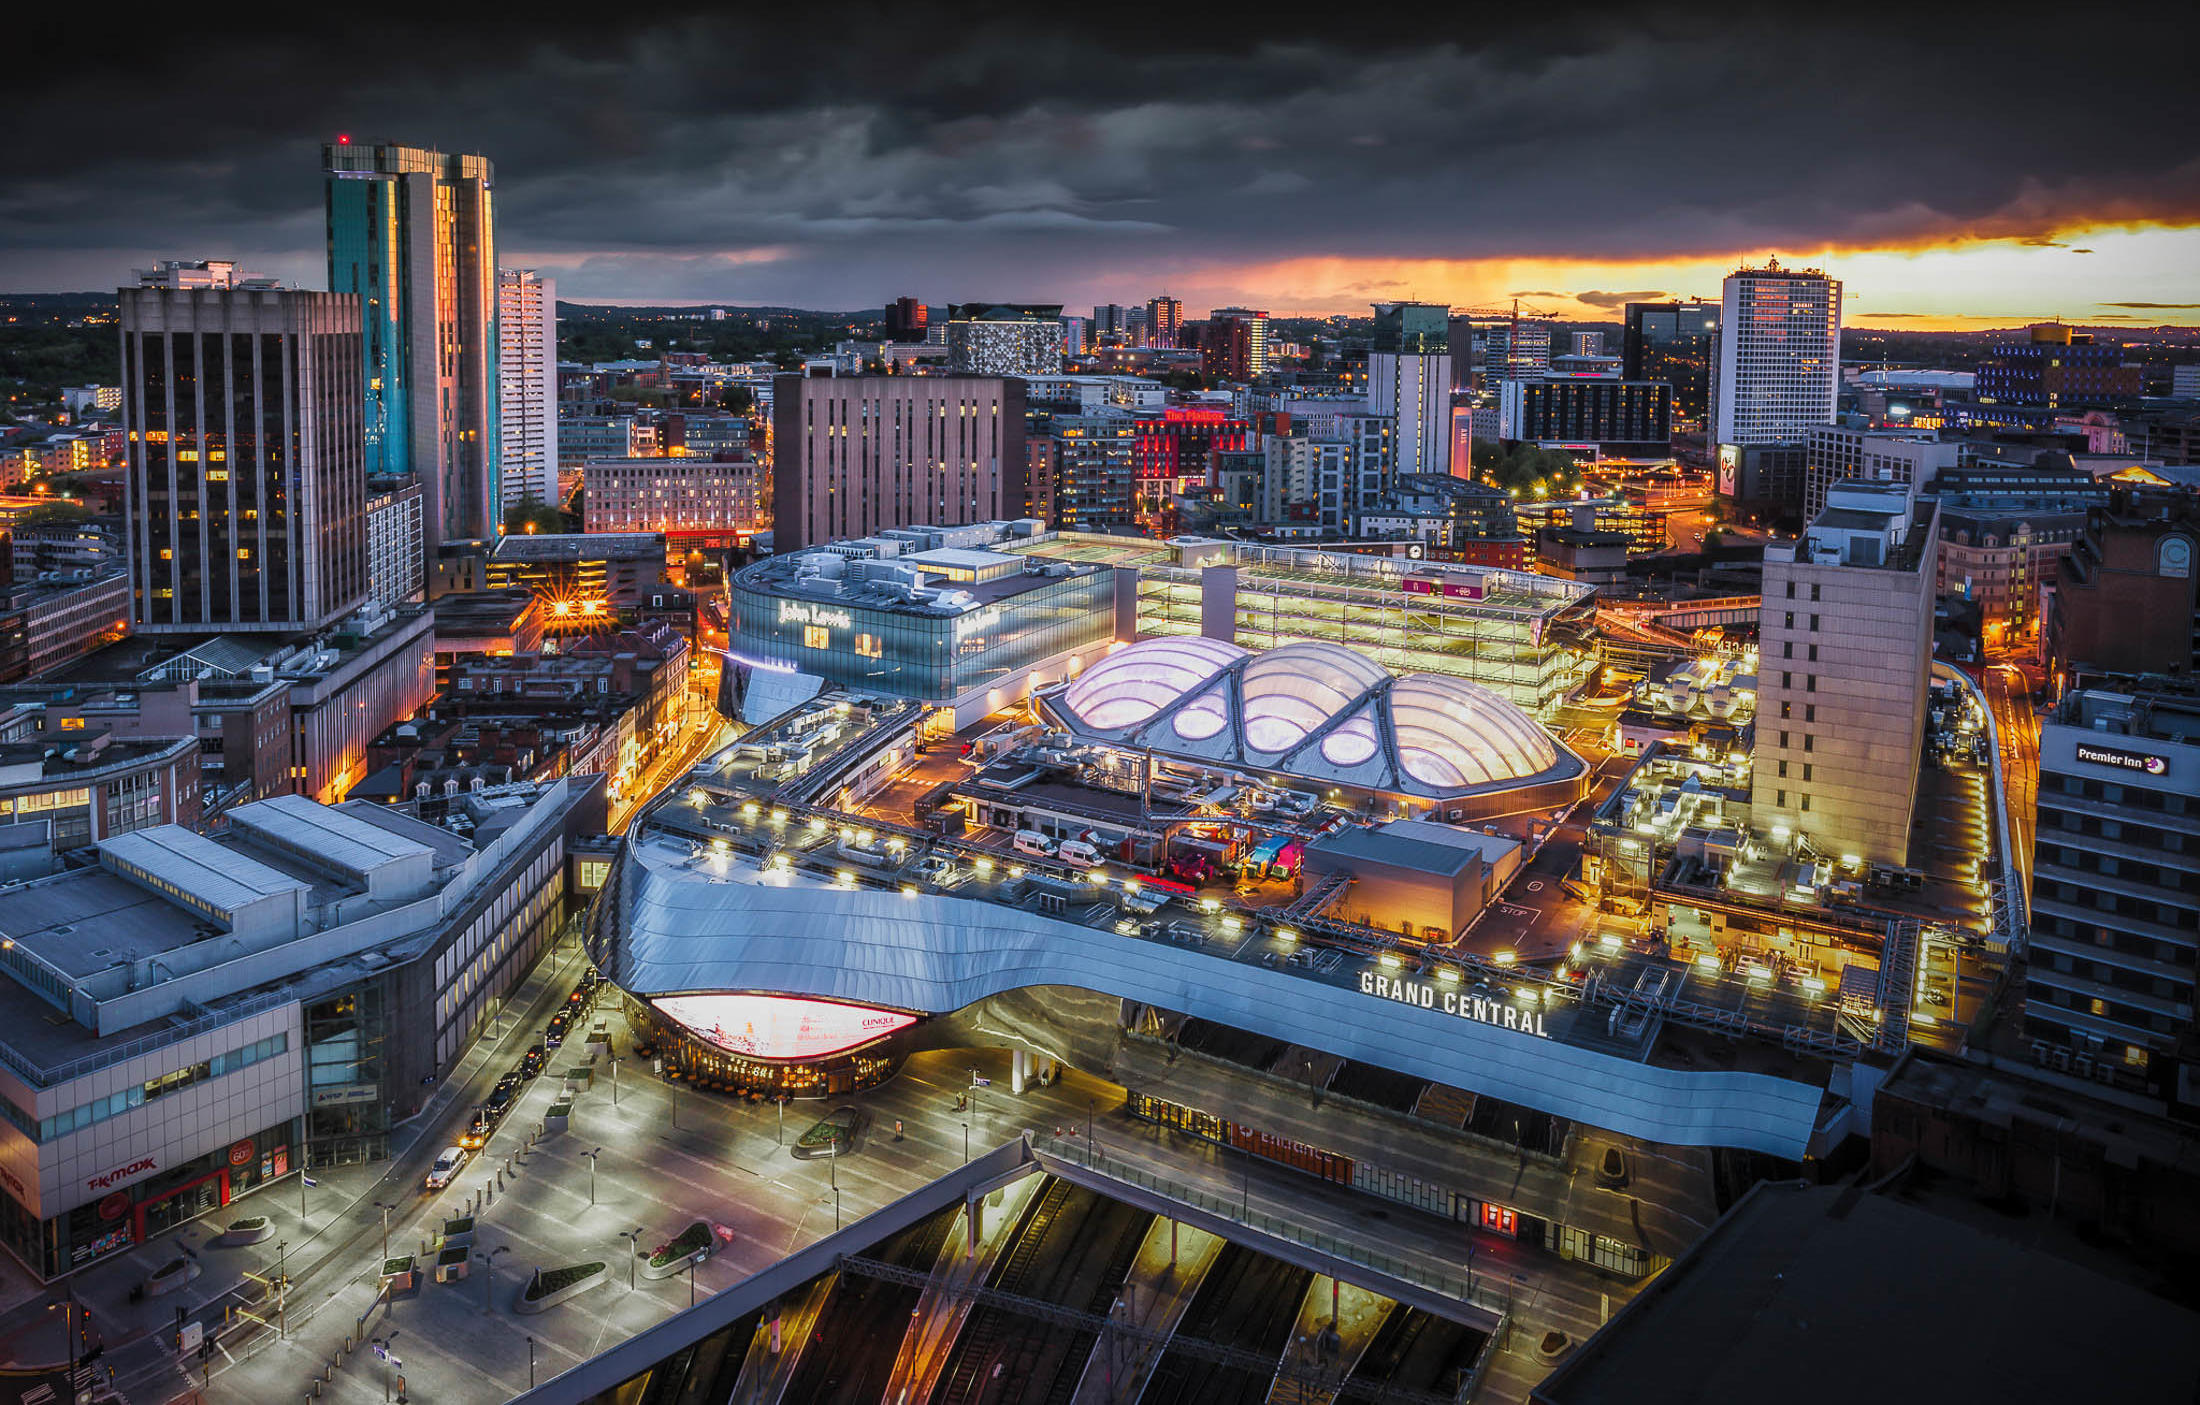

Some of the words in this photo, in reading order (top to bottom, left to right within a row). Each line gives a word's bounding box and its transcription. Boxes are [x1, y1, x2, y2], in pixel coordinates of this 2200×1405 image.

[779, 600, 809, 624] John
[811, 604, 850, 629] Lewis
[2079, 748, 2123, 764] Premier
[2124, 756, 2142, 768] Inn
[1361, 971, 1434, 1009] GRAND
[1443, 992, 1549, 1037] CENTRAL
[862, 1016, 896, 1026] CLINIQUE
